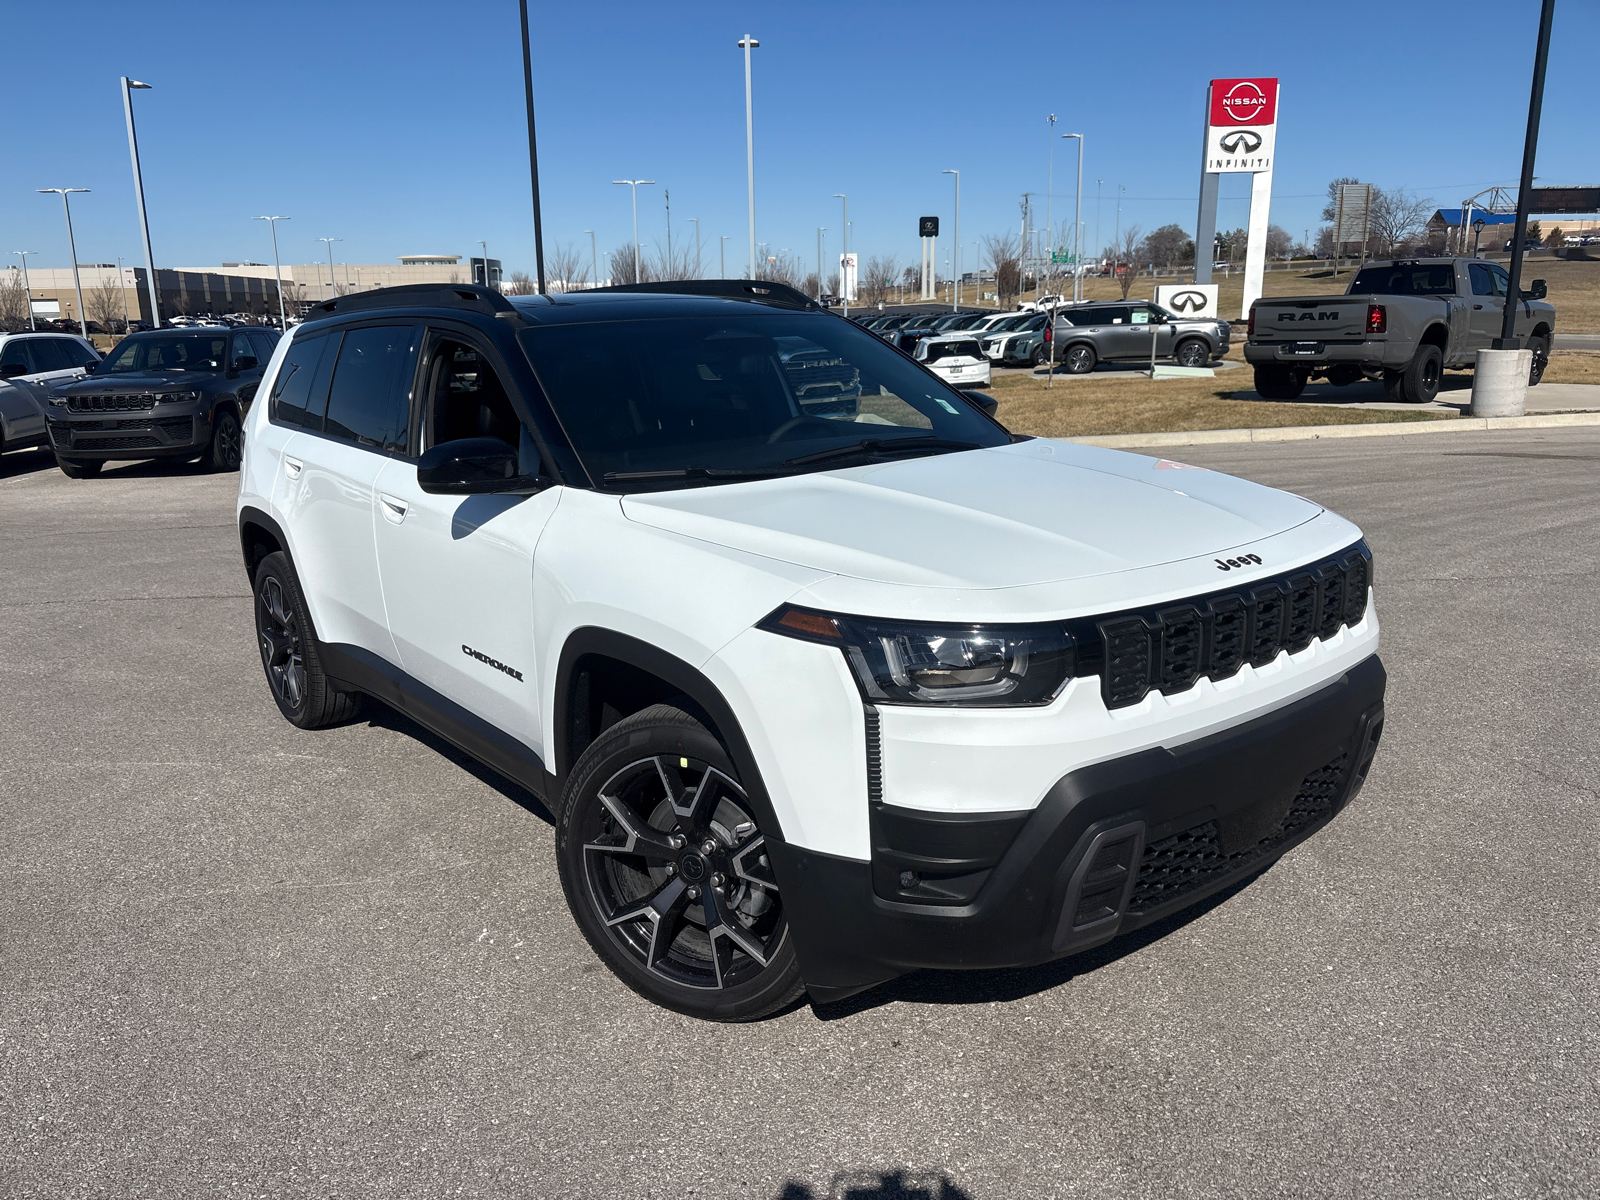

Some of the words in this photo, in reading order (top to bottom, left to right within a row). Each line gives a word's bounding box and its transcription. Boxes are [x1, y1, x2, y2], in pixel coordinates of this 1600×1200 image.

[1222, 97, 1266, 106] NISSAN
[1209, 158, 1270, 168] INFINITI
[1277, 311, 1340, 322] RAM
[1213, 553, 1263, 571] Jeep
[461, 644, 524, 683] CHEROKEE
